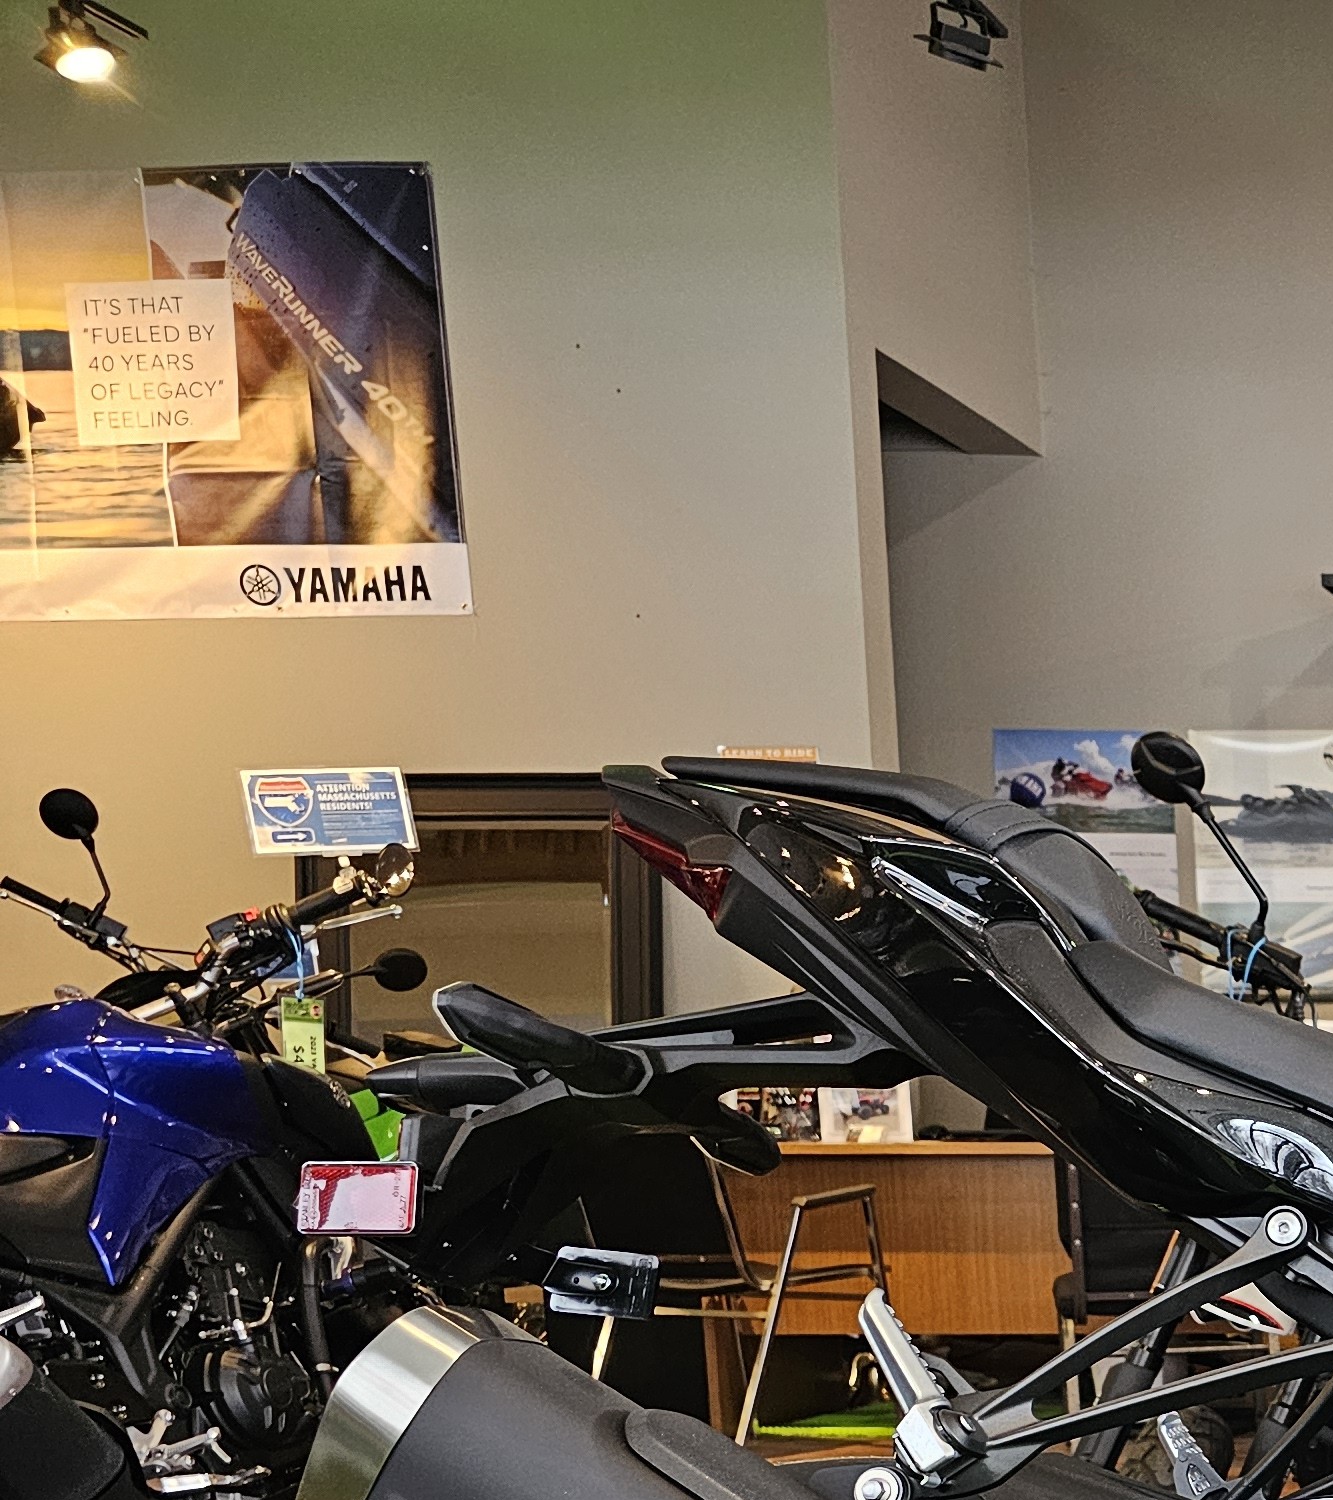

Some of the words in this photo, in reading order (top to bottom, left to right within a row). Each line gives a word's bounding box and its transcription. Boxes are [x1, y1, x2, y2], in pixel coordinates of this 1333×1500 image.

[83, 298, 121, 316] IT'S
[127, 296, 183, 314] THAT
[235, 231, 364, 375] WAVERUNNER
[83, 326, 180, 344] "FUELED
[188, 324, 215, 342] BY
[88, 356, 114, 372] 40
[120, 353, 194, 371] YEARS
[91, 383, 120, 401] OF
[129, 379, 224, 400] LEGACY"
[93, 410, 193, 428] FEELING.
[283, 566, 432, 602] YAMAHA
[317, 792, 397, 801] MASSACHUSETTS
